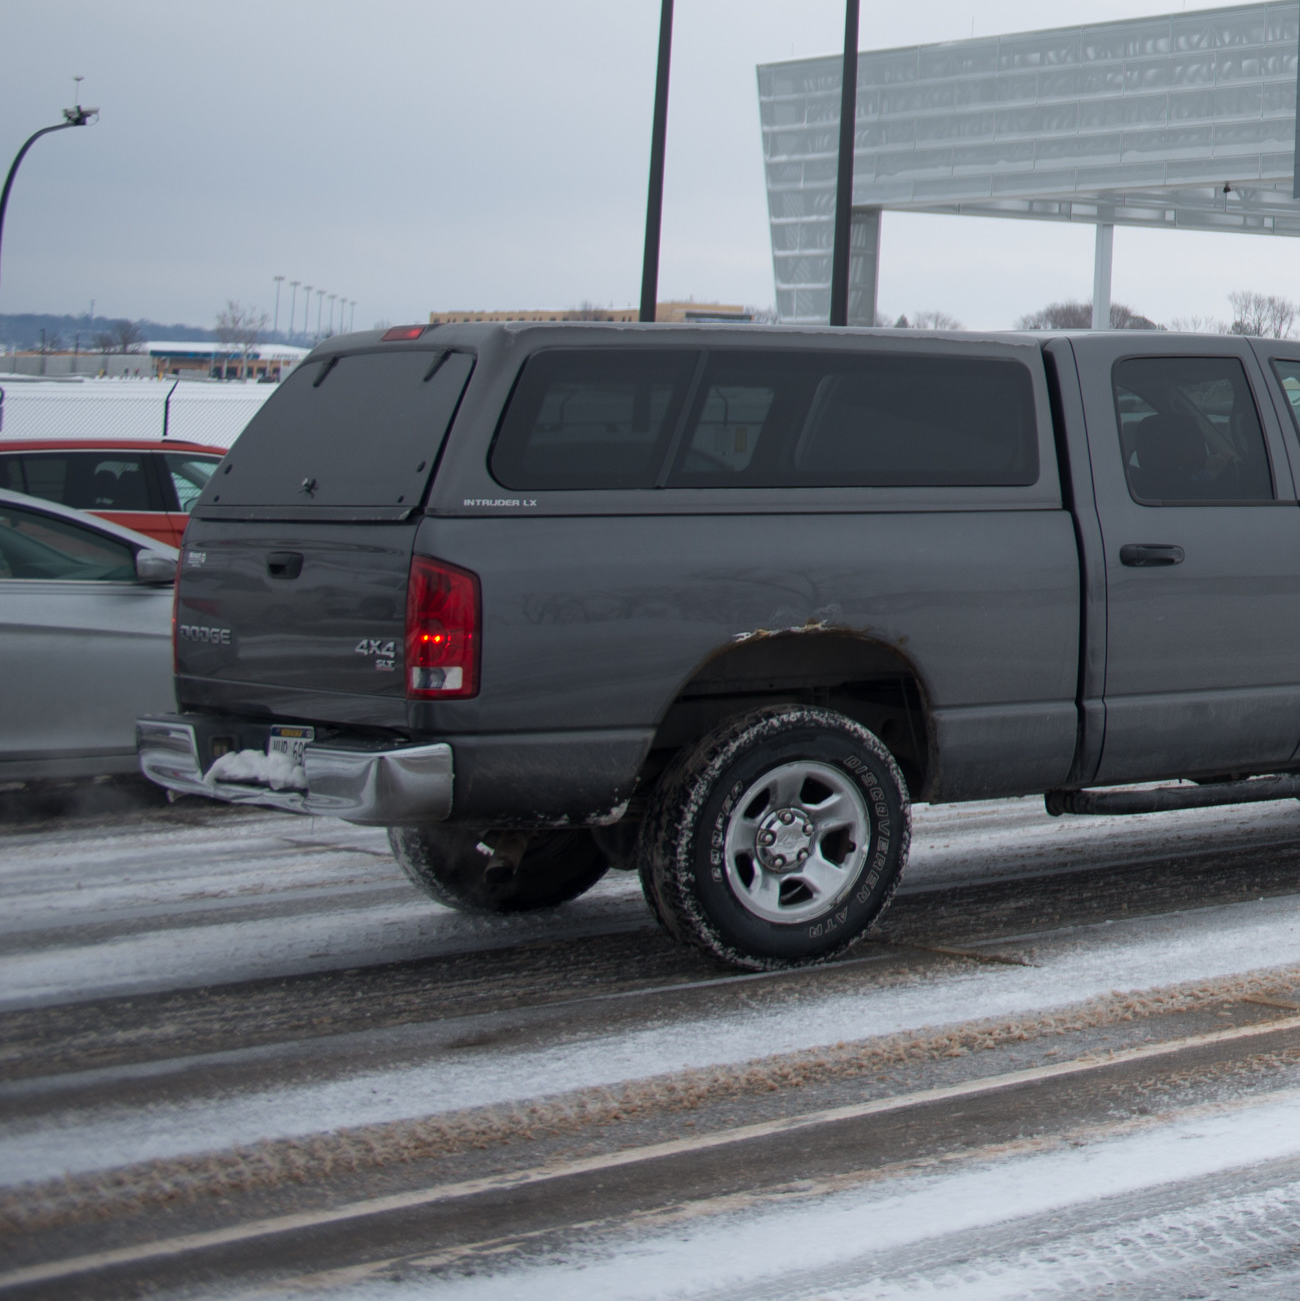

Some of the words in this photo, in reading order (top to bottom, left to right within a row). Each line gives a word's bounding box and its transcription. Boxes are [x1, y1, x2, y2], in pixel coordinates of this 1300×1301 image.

[463, 499, 520, 507] INTRUDER
[180, 624, 231, 645] DODGE
[375, 659, 395, 667] SLT
[710, 780, 744, 882] COOPER
[843, 755, 891, 904] DISCOVERER
